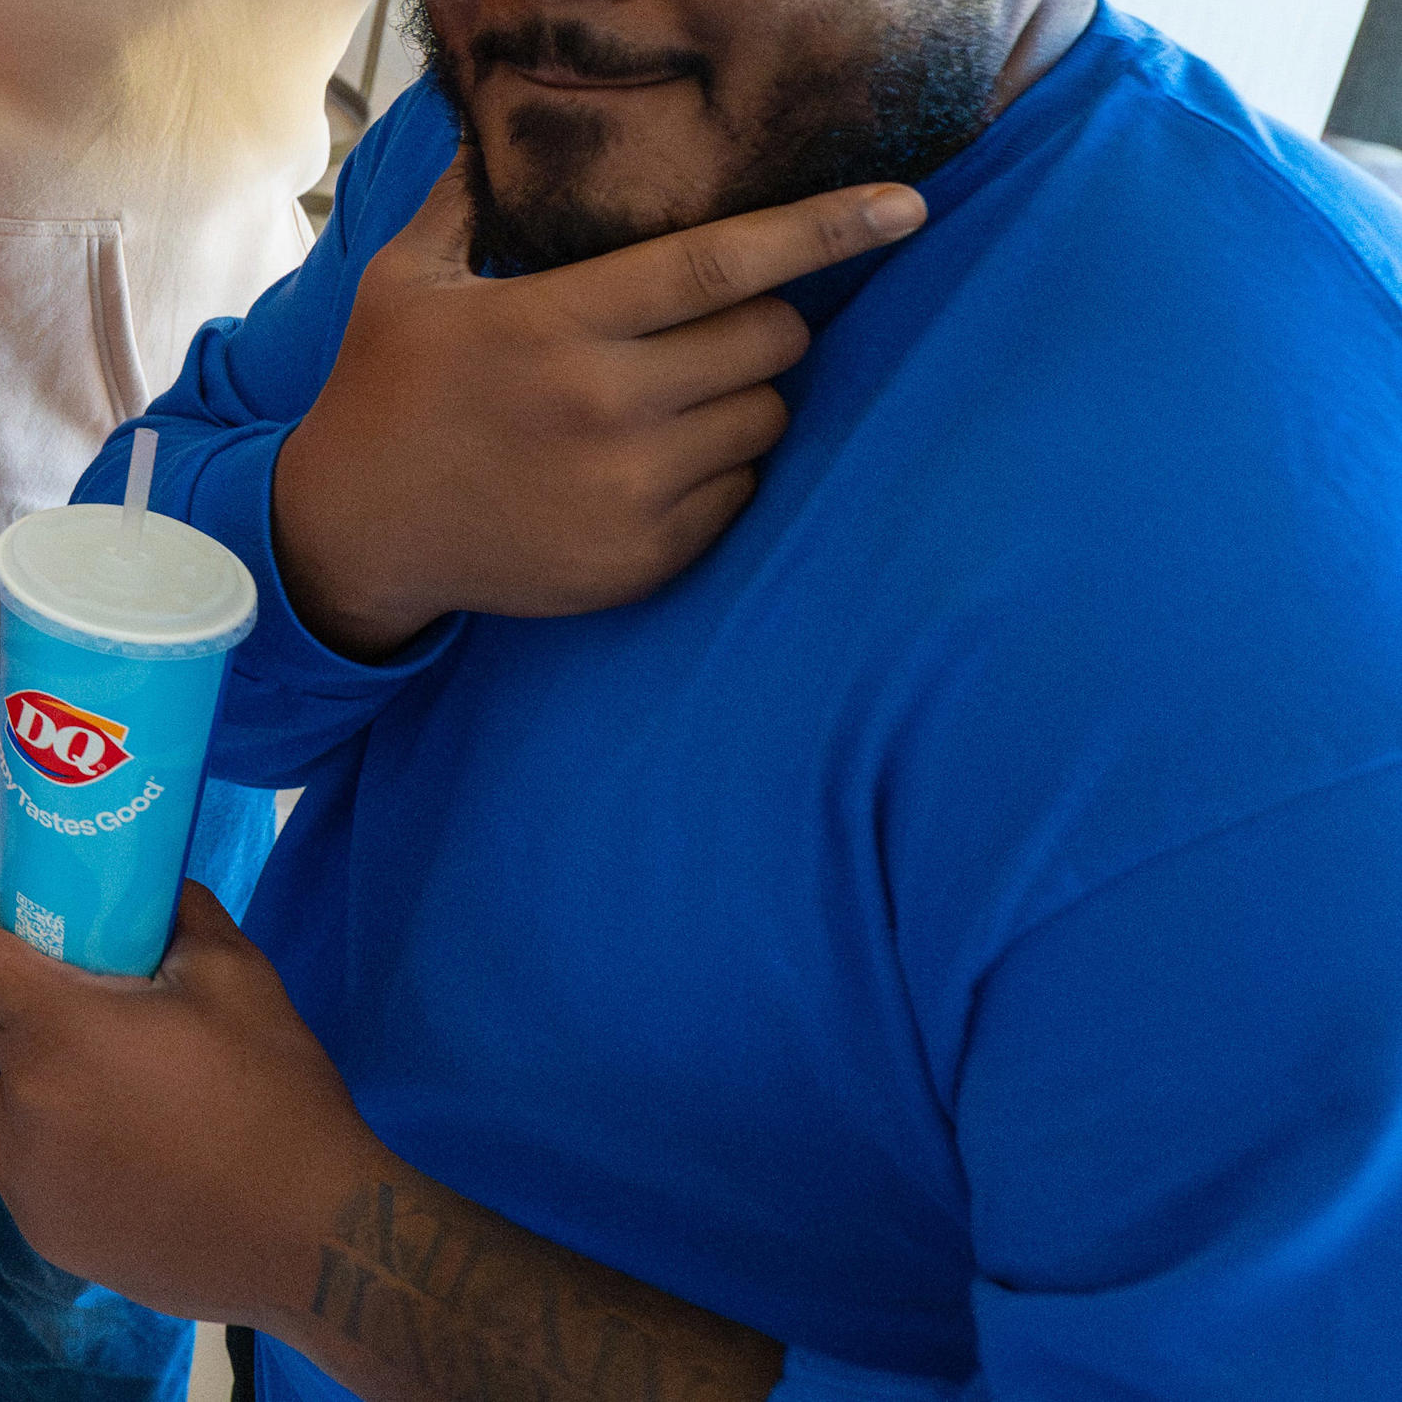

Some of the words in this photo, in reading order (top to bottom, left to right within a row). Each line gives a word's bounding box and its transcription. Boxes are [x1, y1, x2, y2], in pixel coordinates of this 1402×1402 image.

[15, 697, 106, 776] DQ
[17, 785, 98, 837] Tastes
[95, 779, 166, 832] Good
